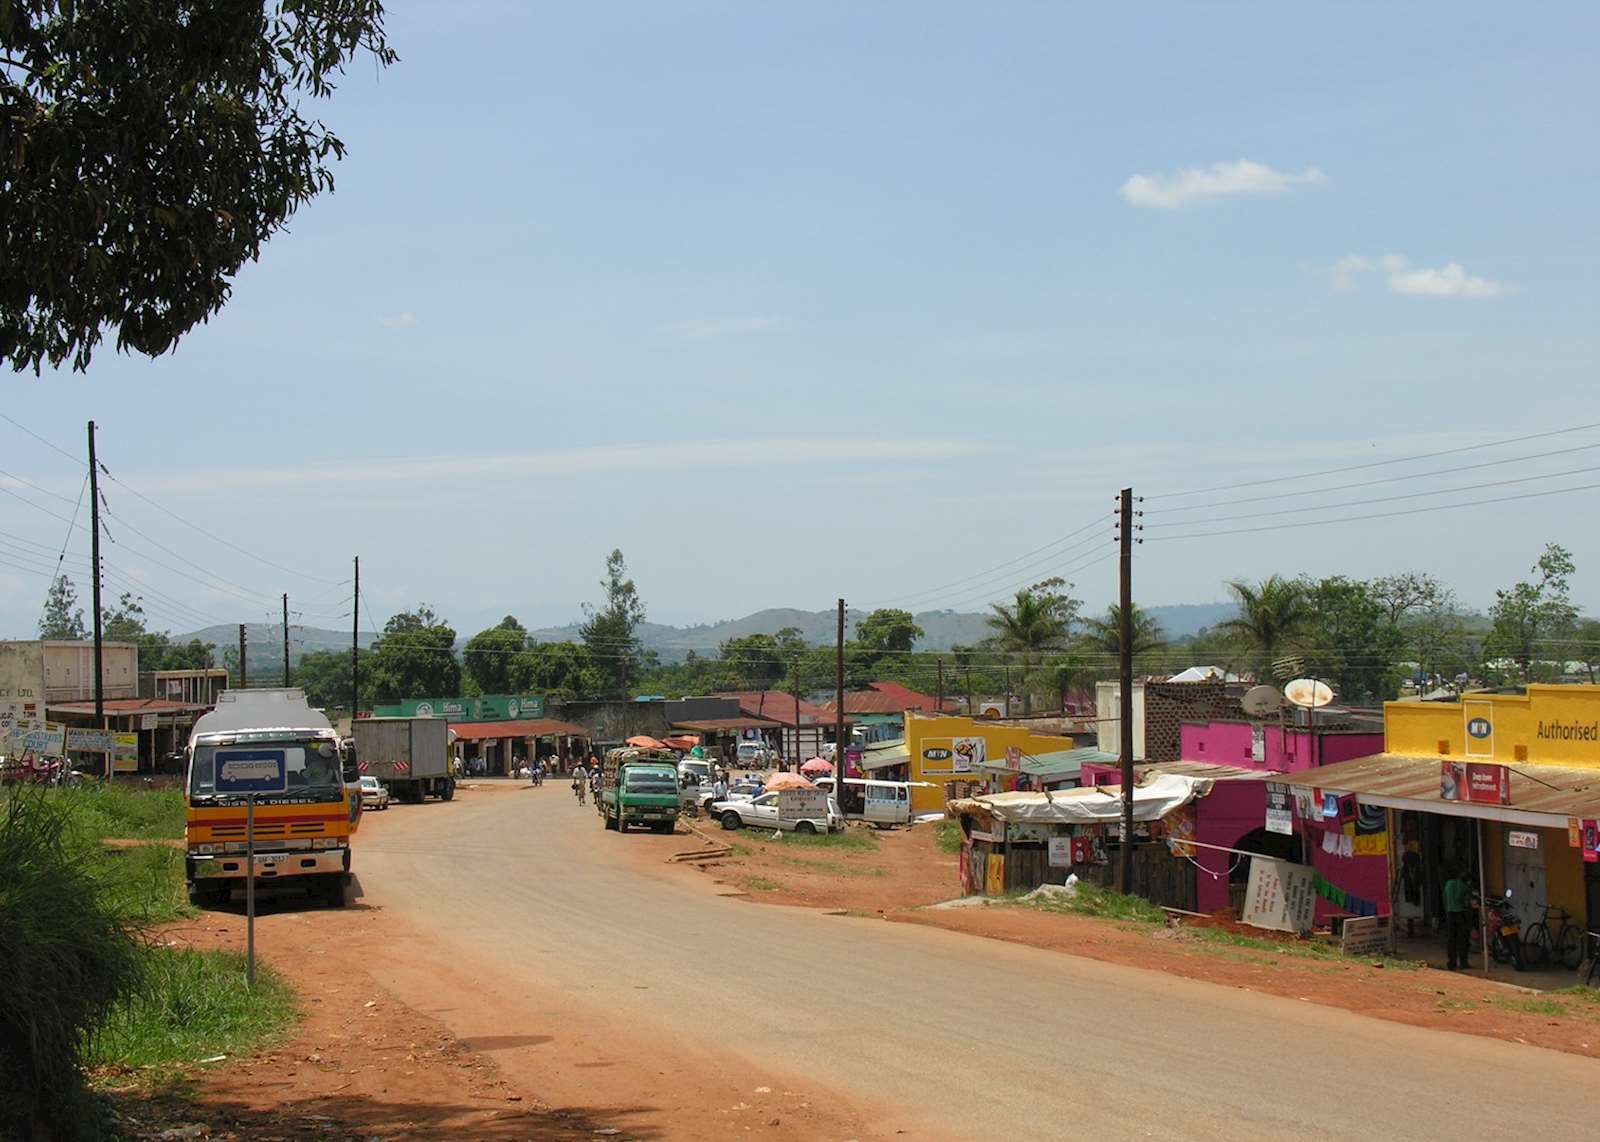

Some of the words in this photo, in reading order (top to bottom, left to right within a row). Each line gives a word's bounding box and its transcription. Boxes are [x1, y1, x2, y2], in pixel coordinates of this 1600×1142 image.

[1471, 722, 1488, 734] MTN
[1537, 720, 1598, 741] Authorised
[927, 750, 947, 758] MTN
